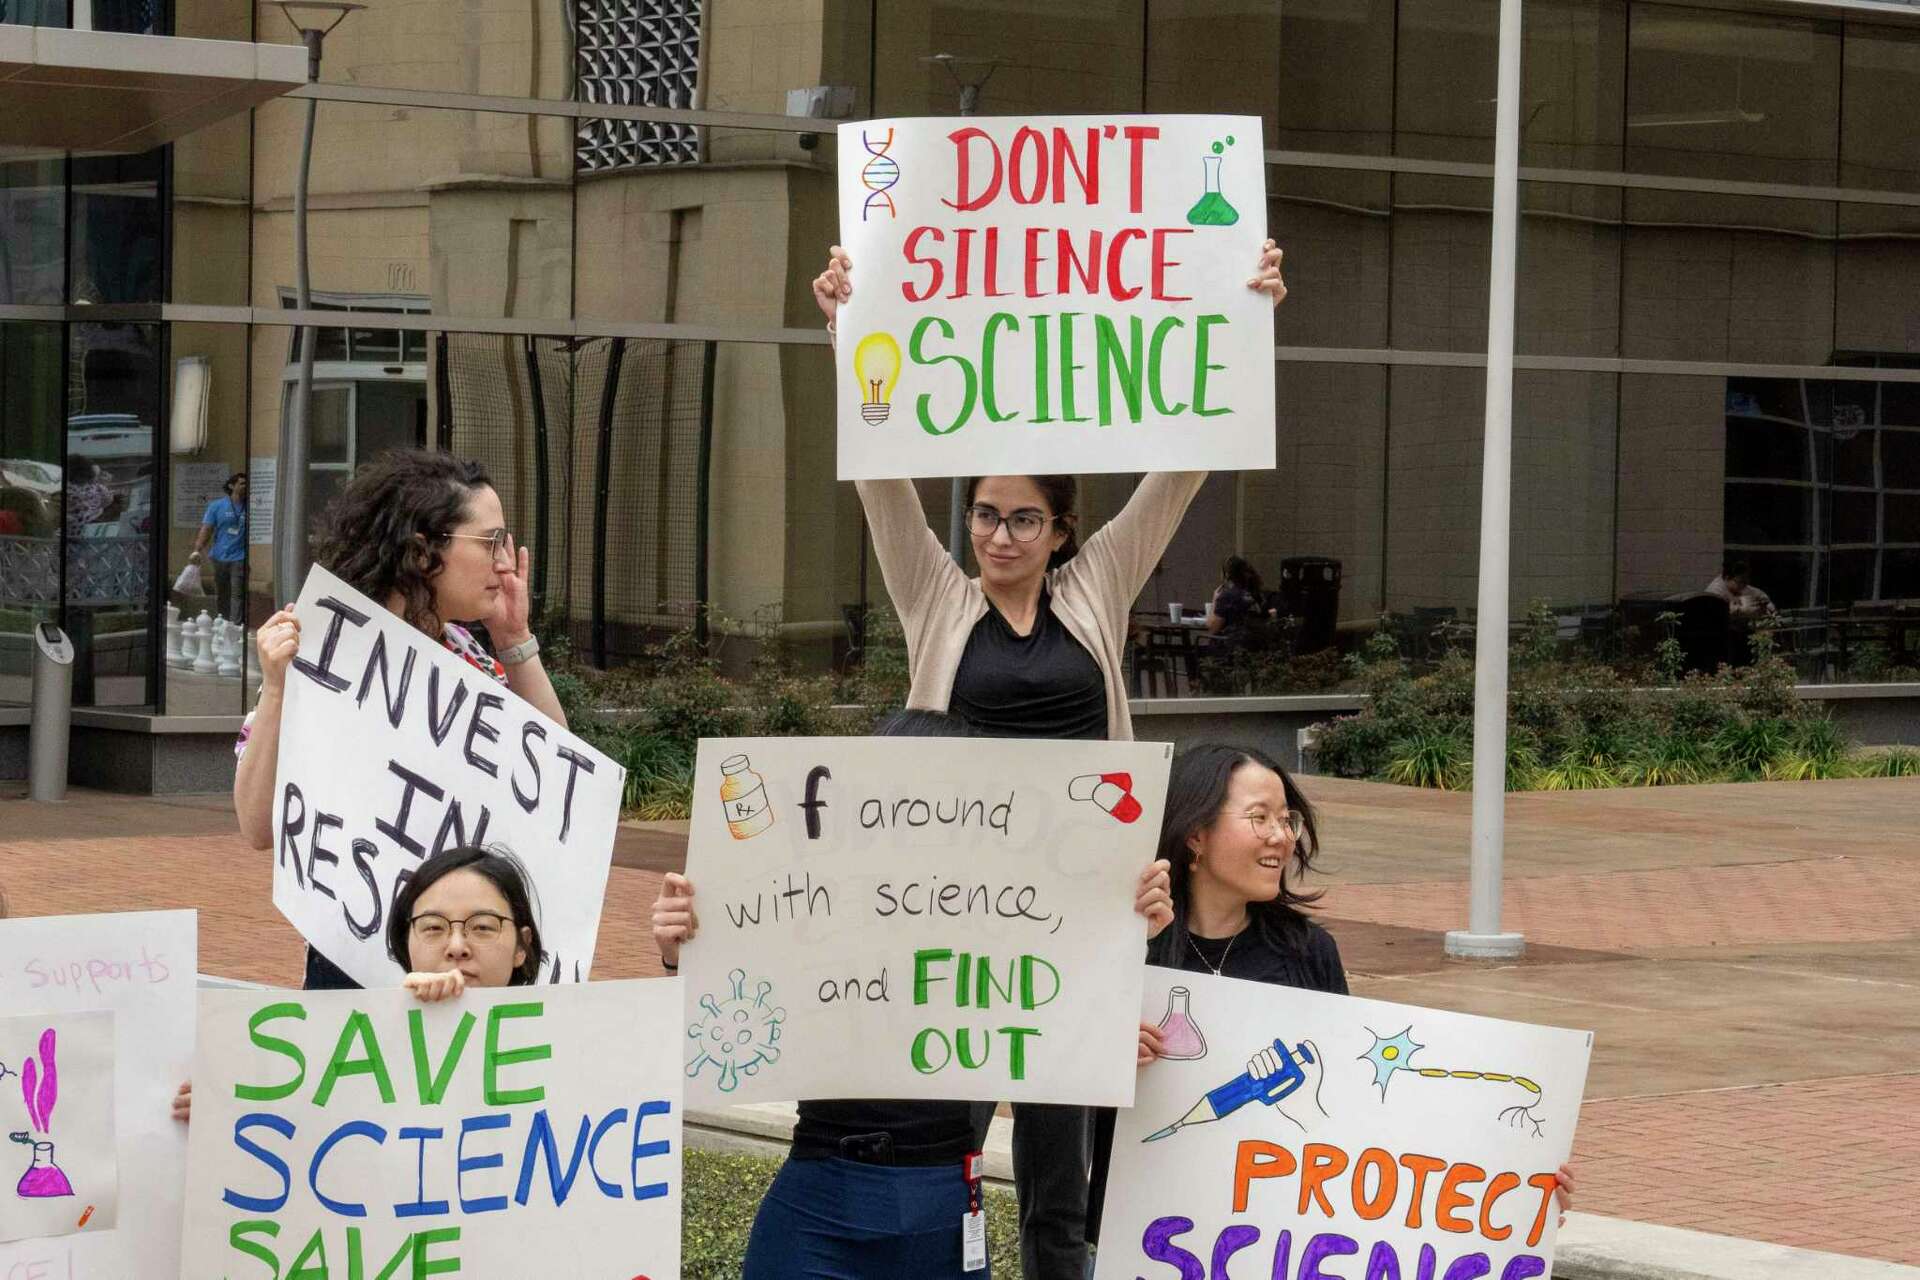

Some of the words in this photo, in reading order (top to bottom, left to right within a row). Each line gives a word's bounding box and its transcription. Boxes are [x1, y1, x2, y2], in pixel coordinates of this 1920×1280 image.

[941, 125, 1160, 213] DON'T
[901, 226, 1194, 302] SILENCE
[909, 312, 1236, 435] SCIENCE
[293, 596, 595, 845] INVEST
[376, 758, 491, 861] IN
[798, 765, 832, 839] f
[860, 790, 1015, 836] around
[725, 871, 833, 929] with
[875, 875, 1063, 935] science,
[818, 967, 890, 1004] and
[913, 948, 1060, 1011] FIND
[234, 1001, 552, 1107] SAVE
[910, 1025, 1043, 1081] OUT
[222, 1101, 672, 1218] SCIENCE
[1231, 1138, 1559, 1248] PROTECT
[223, 1219, 461, 1280] SAVE
